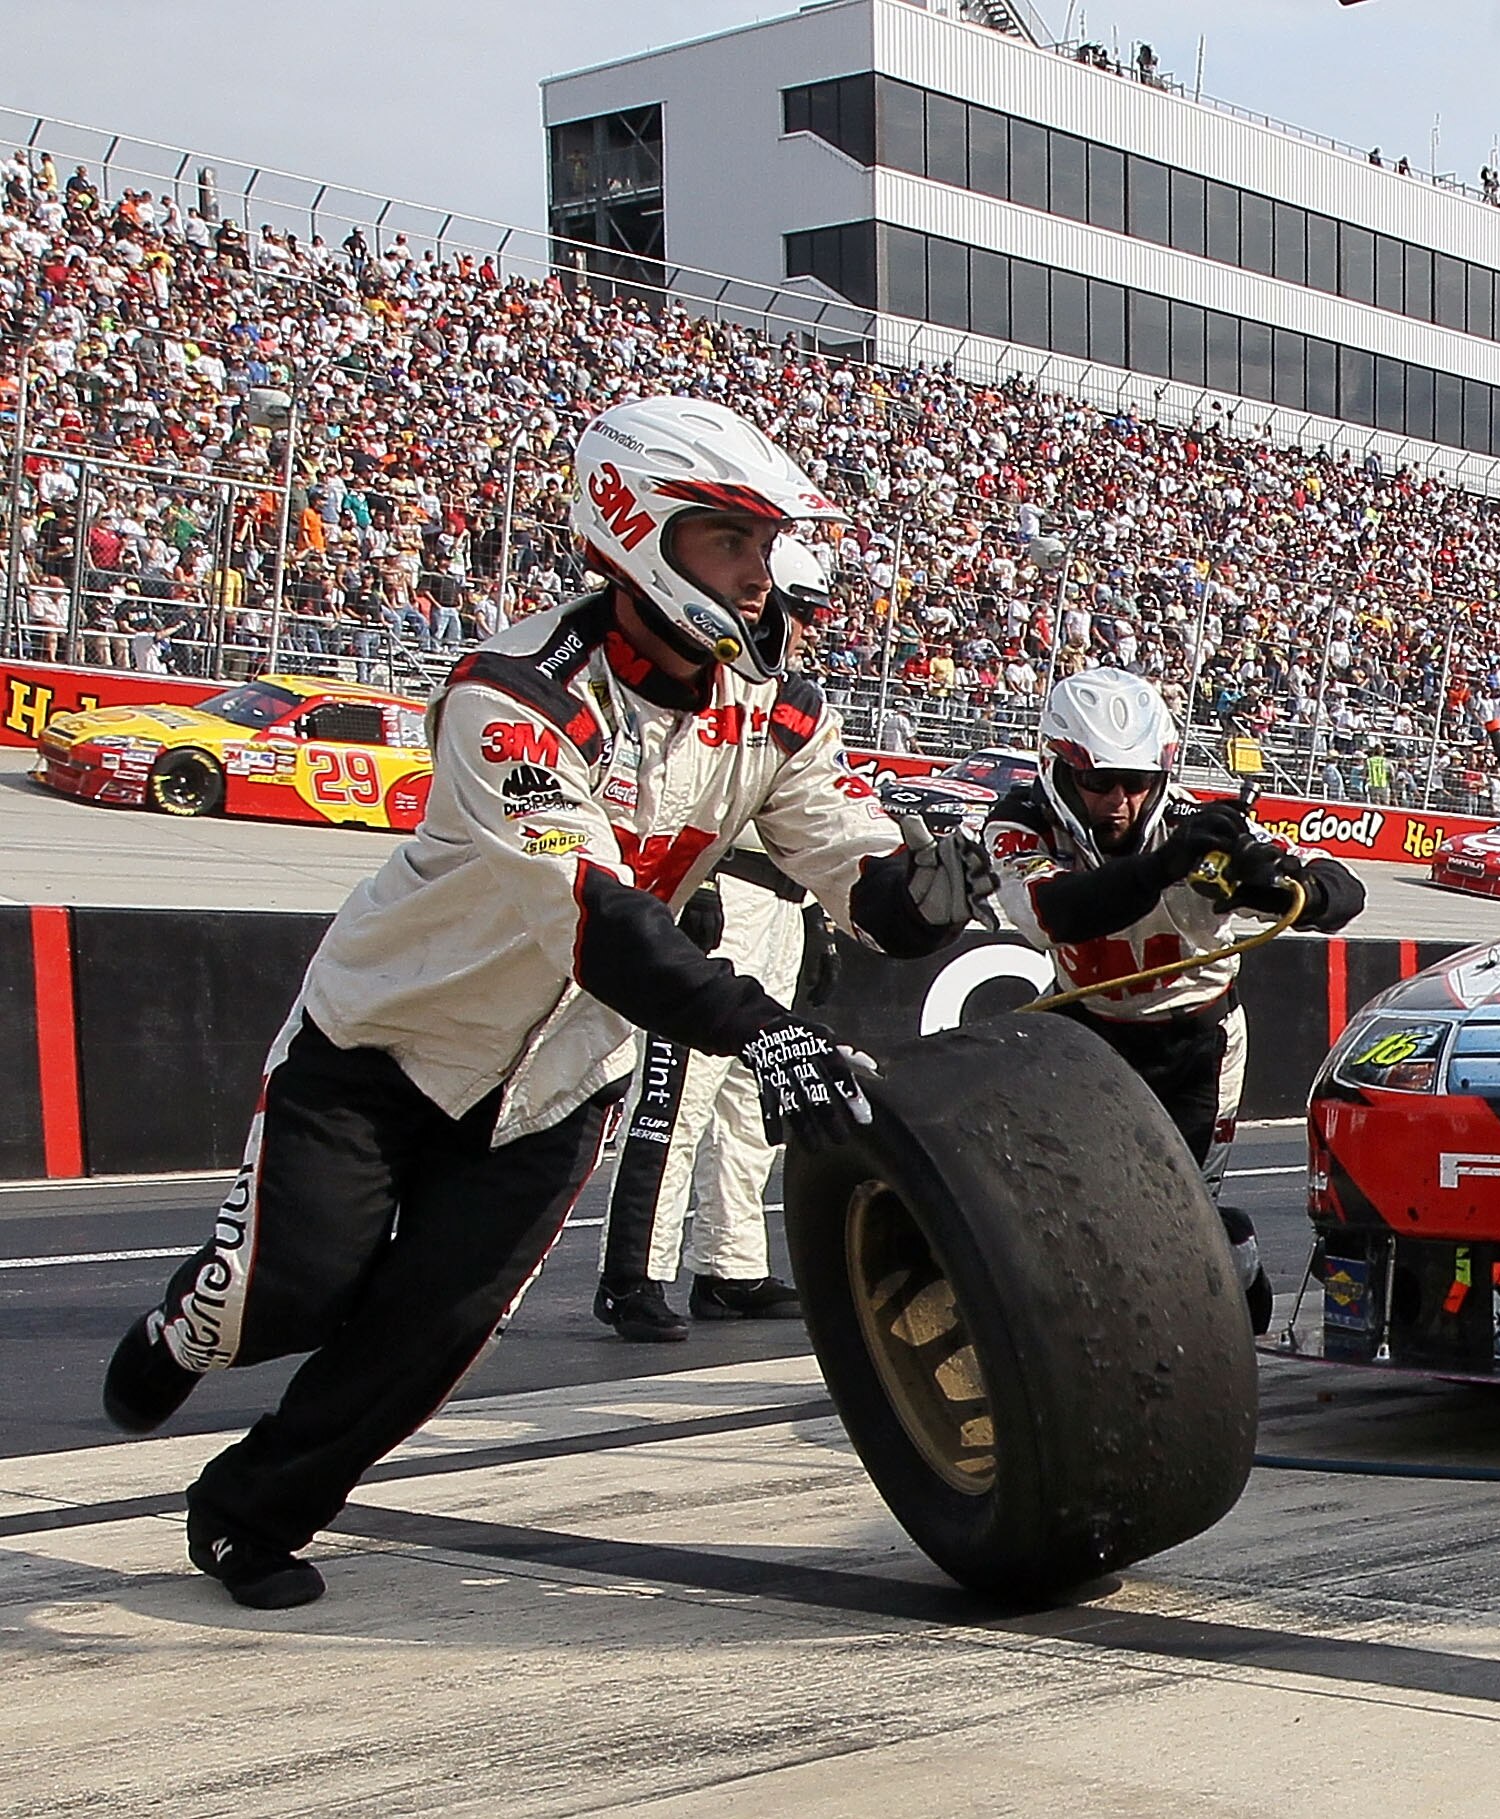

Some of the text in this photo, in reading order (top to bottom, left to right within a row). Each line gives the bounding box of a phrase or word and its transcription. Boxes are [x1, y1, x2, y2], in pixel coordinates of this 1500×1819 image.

[588, 461, 657, 552] 3M
[772, 703, 816, 738] 3M
[482, 722, 560, 767] 3M
[307, 746, 380, 806] 29
[529, 834, 585, 853] SUNOCO
[1300, 808, 1384, 847] Good!
[1353, 1033, 1418, 1067] 16
[647, 1041, 678, 1104] rint
[629, 1127, 671, 1144] SERIES
[638, 1116, 669, 1129] CUP
